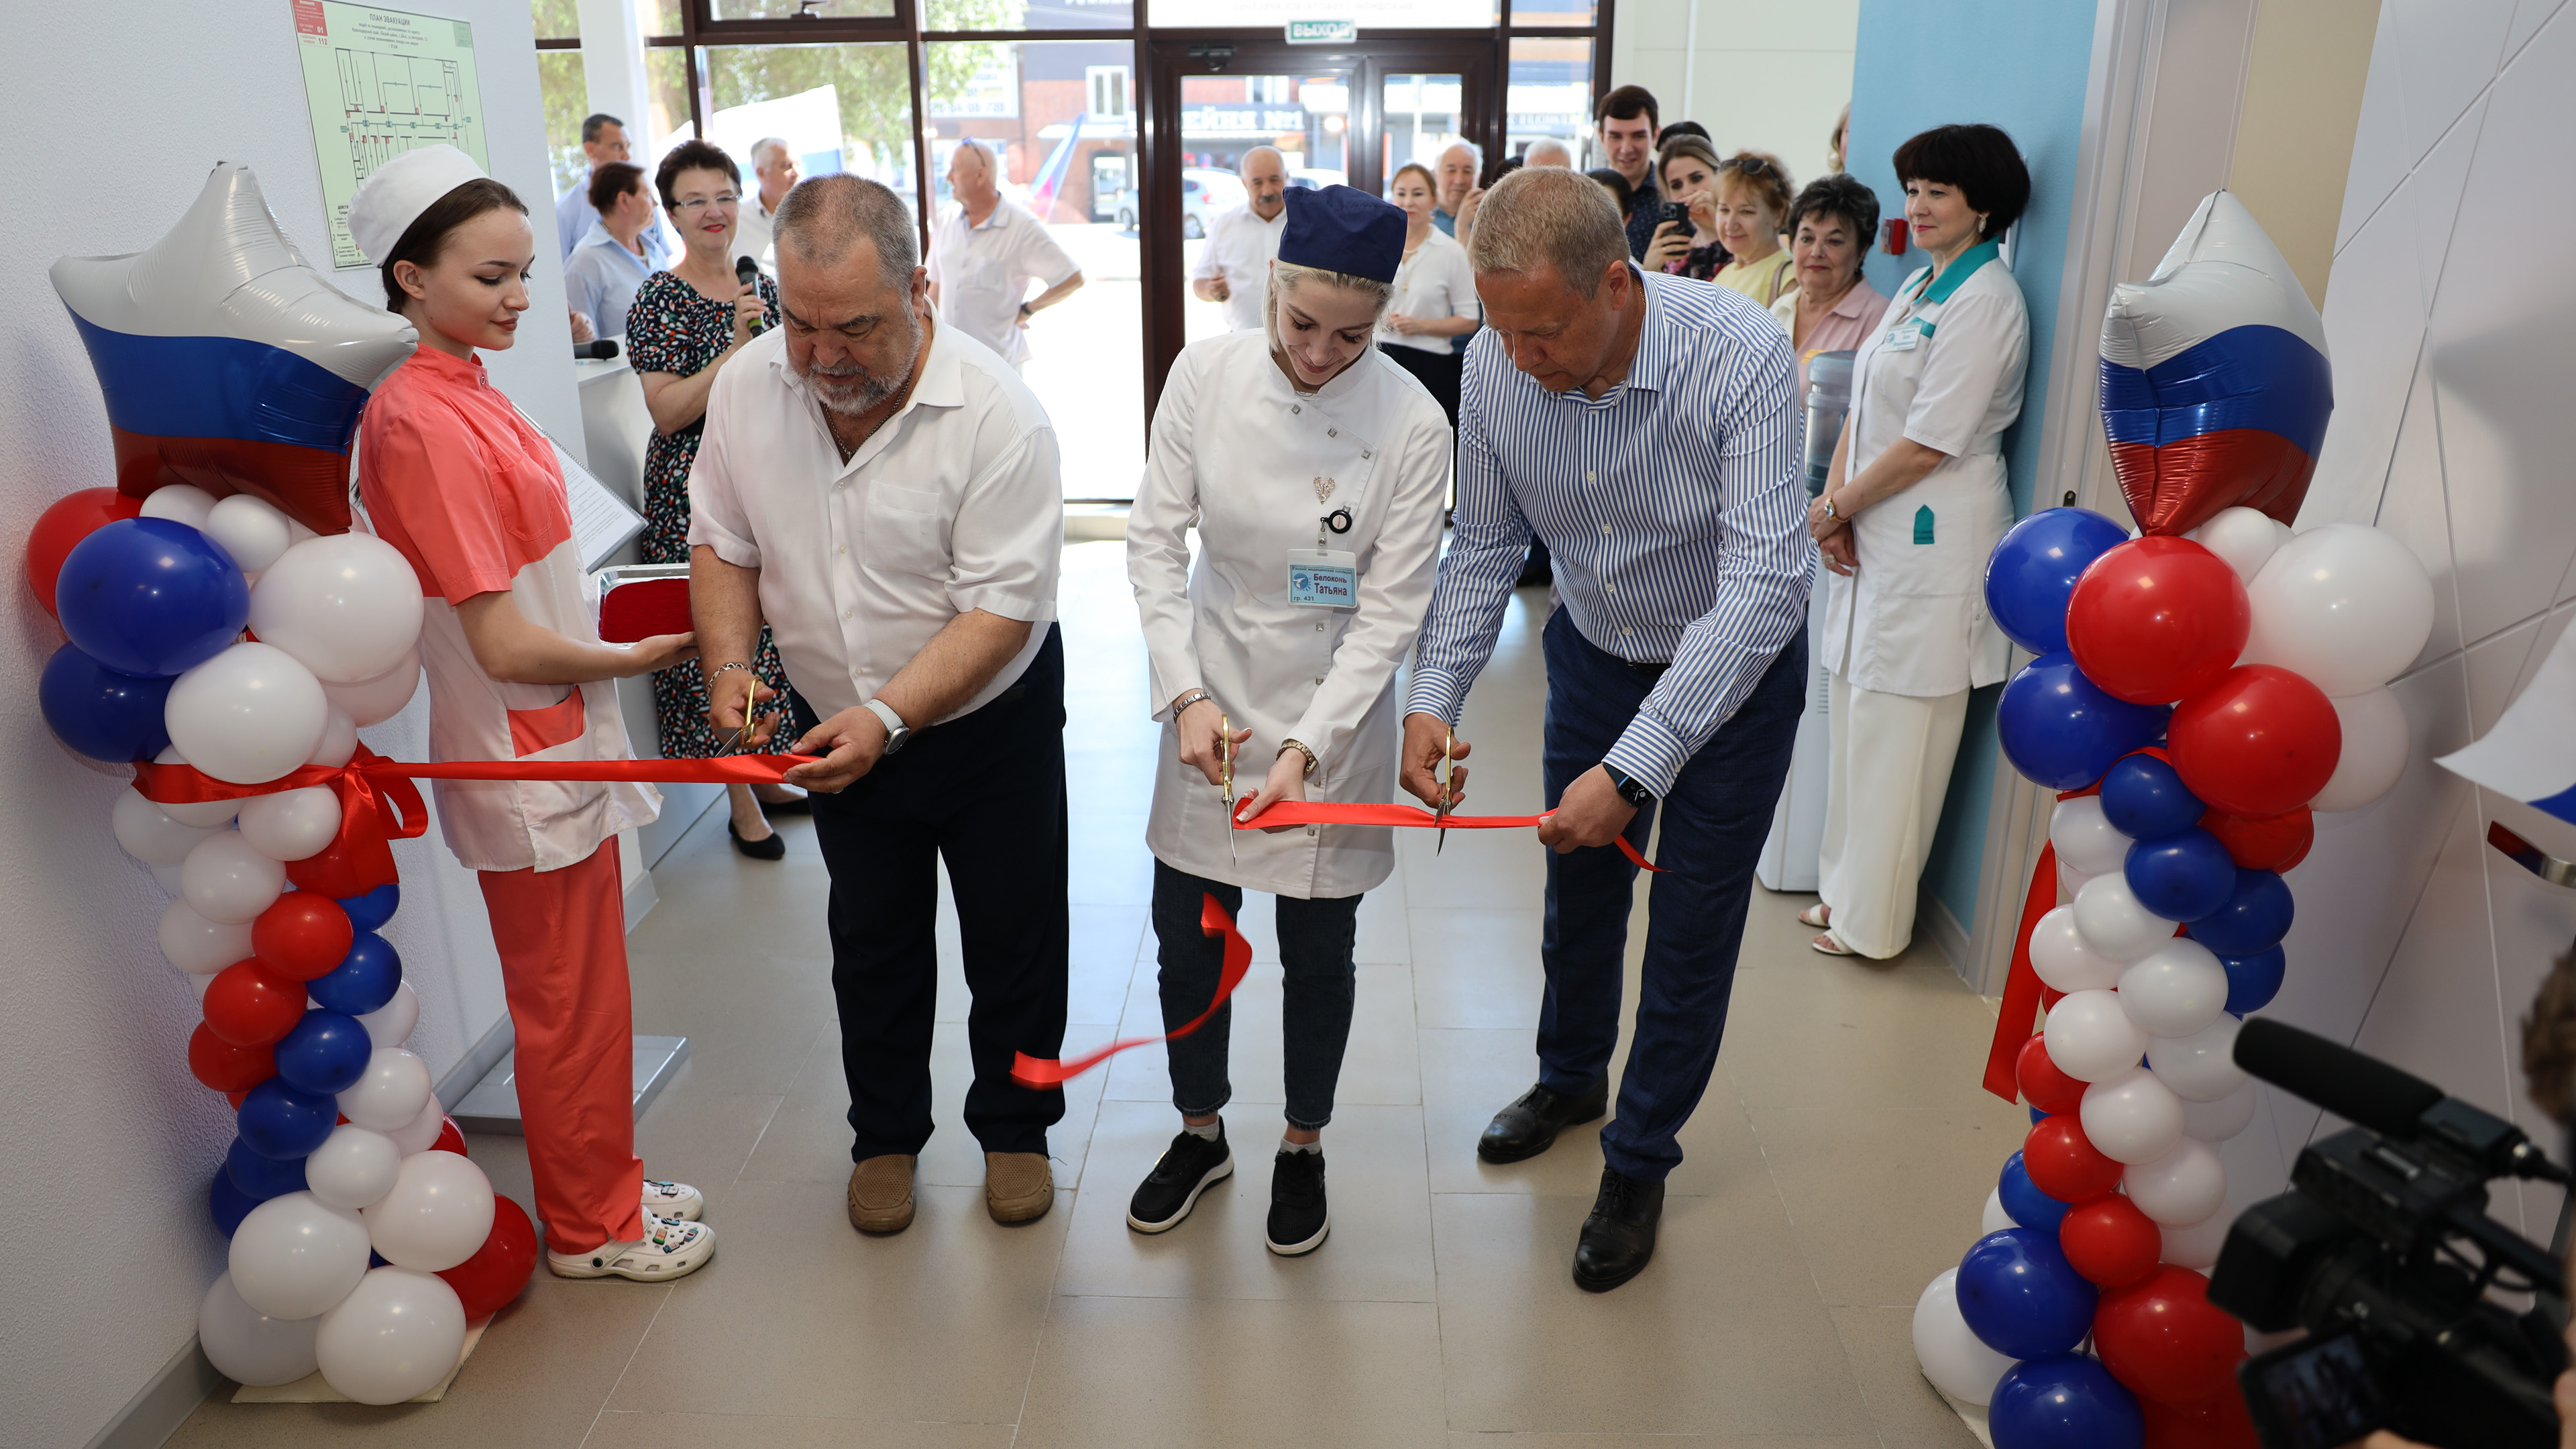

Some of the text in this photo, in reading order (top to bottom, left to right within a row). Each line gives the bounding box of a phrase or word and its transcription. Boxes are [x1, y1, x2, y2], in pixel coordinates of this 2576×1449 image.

[369, 13, 383, 21] ПЛАН
[383, 15, 411, 26] ЭВАКУАЦИИ
[1293, 23, 1350, 37] ВЫХОД
[333, 233, 336, 241] 2
[1313, 574, 1347, 583] Белоконь
[1314, 583, 1347, 596] Татьяна
